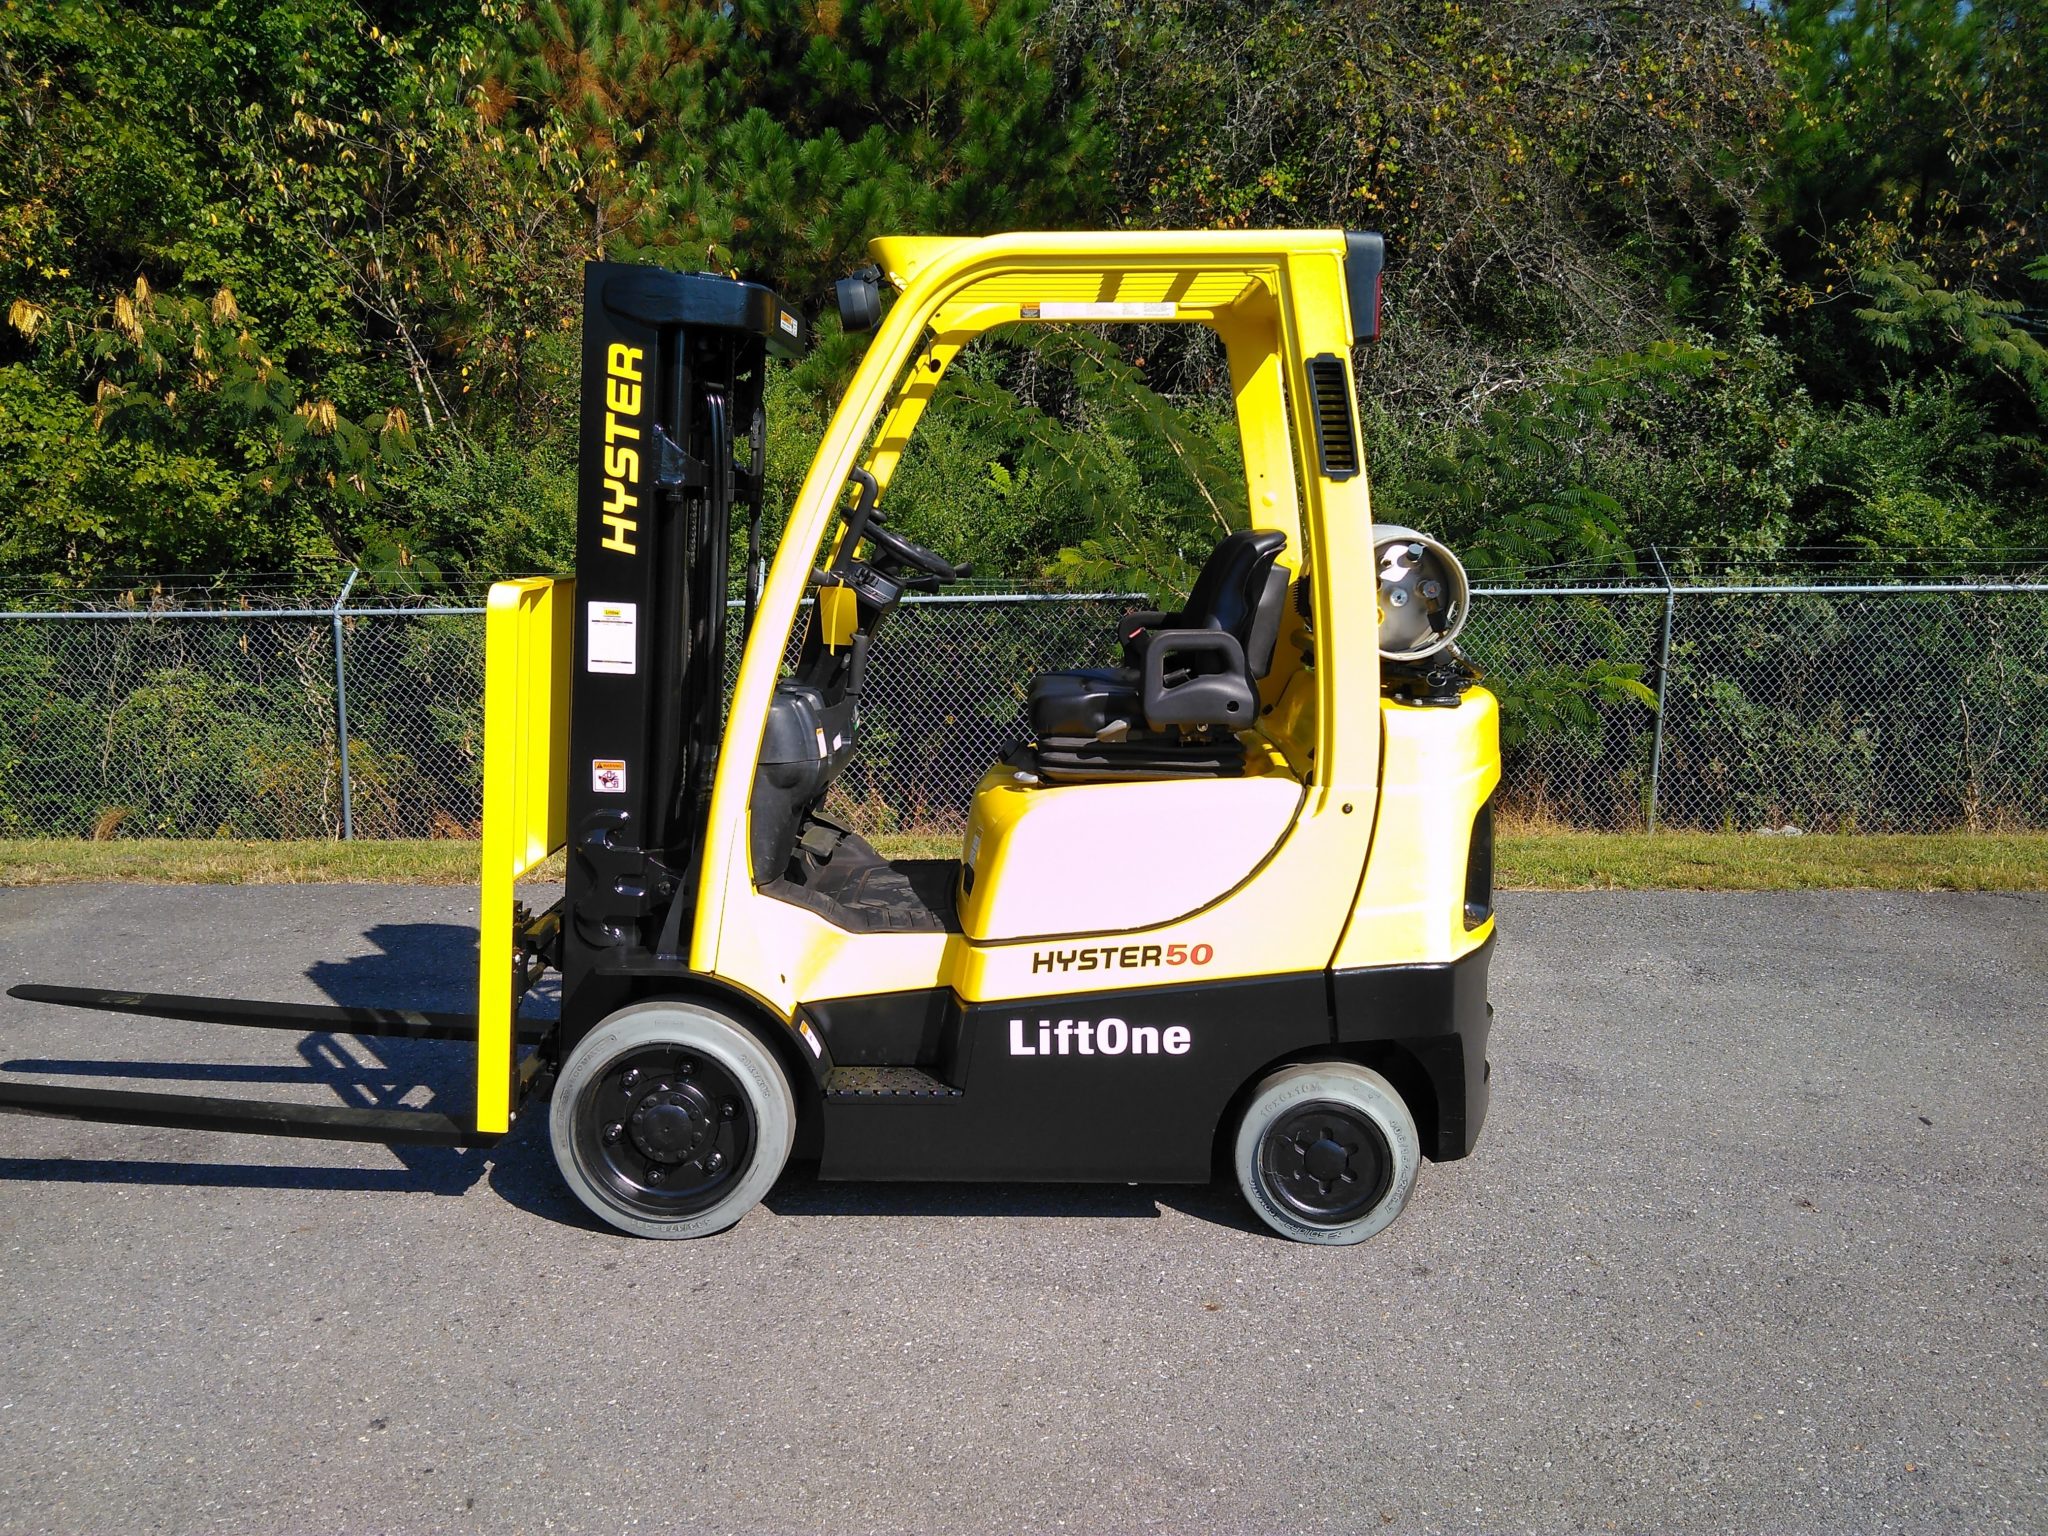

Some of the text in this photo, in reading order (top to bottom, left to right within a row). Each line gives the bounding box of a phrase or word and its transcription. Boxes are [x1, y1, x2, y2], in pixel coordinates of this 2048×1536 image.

[601, 343, 643, 556] HYSTER
[1032, 943, 1214, 974] HYSTER 50
[1009, 1018, 1191, 1056] LiftOne
